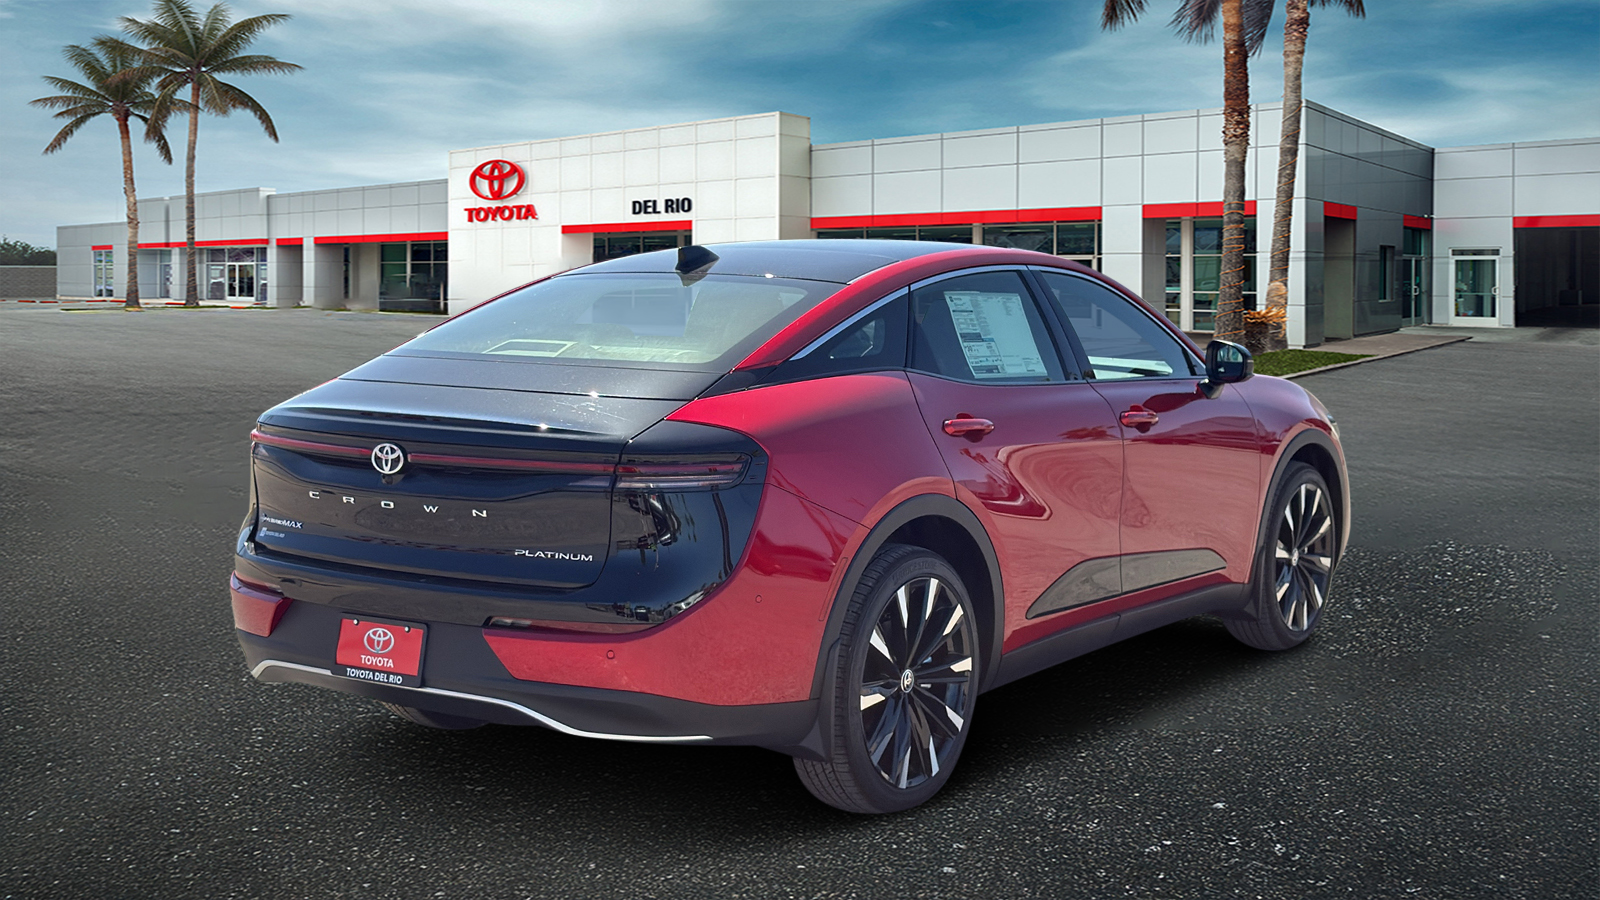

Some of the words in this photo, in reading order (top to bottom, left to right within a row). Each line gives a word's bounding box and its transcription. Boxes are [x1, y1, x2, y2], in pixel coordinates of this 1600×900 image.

[464, 204, 538, 223] TOYOTA
[632, 199, 661, 216] DEL
[664, 197, 692, 214] RIO
[309, 490, 488, 518] CROWN
[514, 549, 593, 561] PLATINUM
[360, 655, 394, 668] TOYOTA
[346, 668, 374, 680] TOYOTA
[374, 672, 388, 682] DEL
[388, 675, 403, 684] RIO
